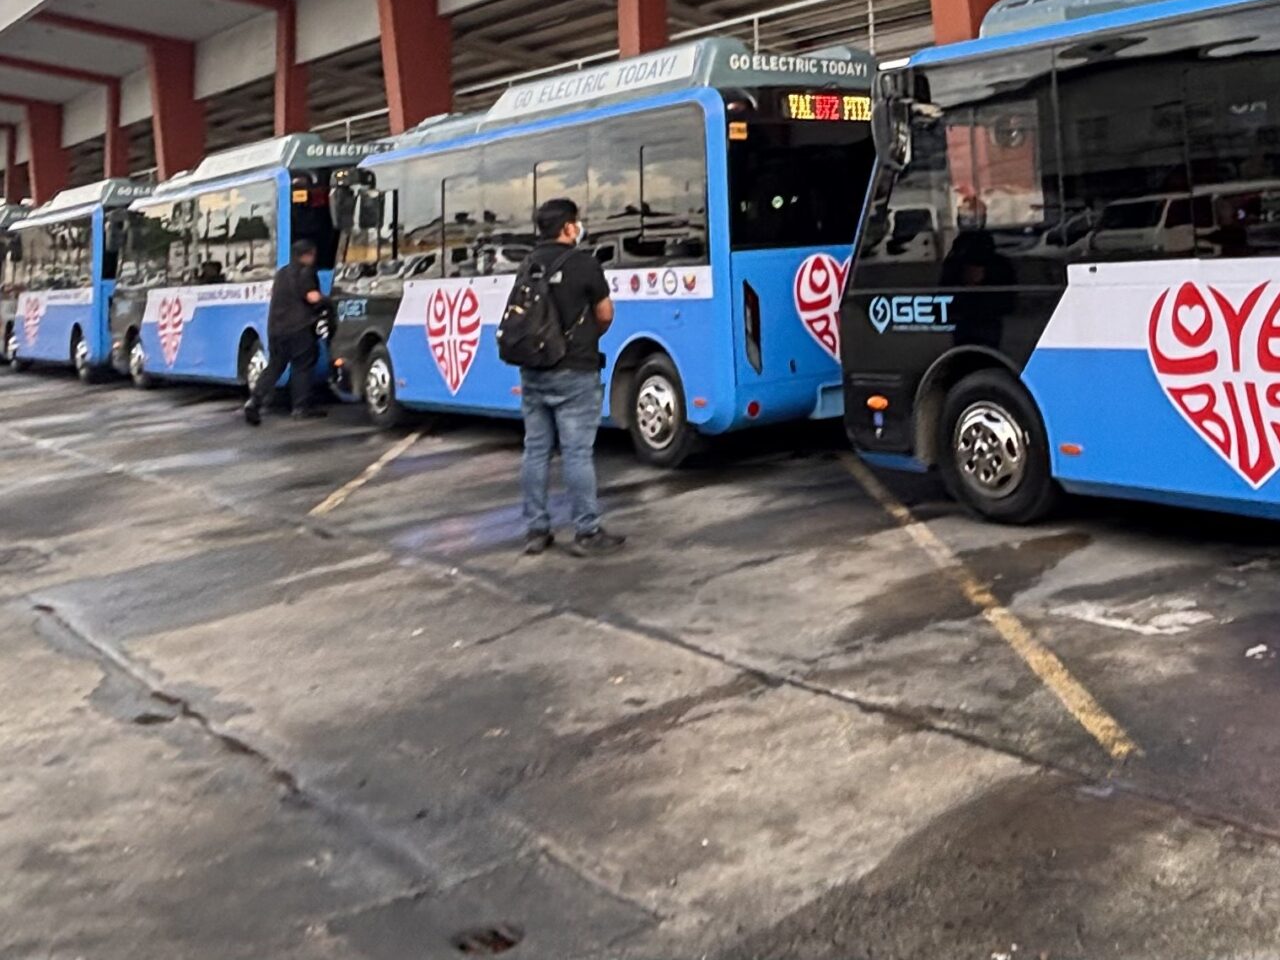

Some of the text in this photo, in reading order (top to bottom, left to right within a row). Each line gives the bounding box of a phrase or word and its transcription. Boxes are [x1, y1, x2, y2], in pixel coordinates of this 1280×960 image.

[729, 54, 867, 77] GO ELECTRIC TODAY!
[514, 55, 677, 110] GO ELECTRIC TODAY!
[307, 144, 323, 156] GO
[892, 296, 954, 323] GET
[432, 338, 478, 390] BUS
